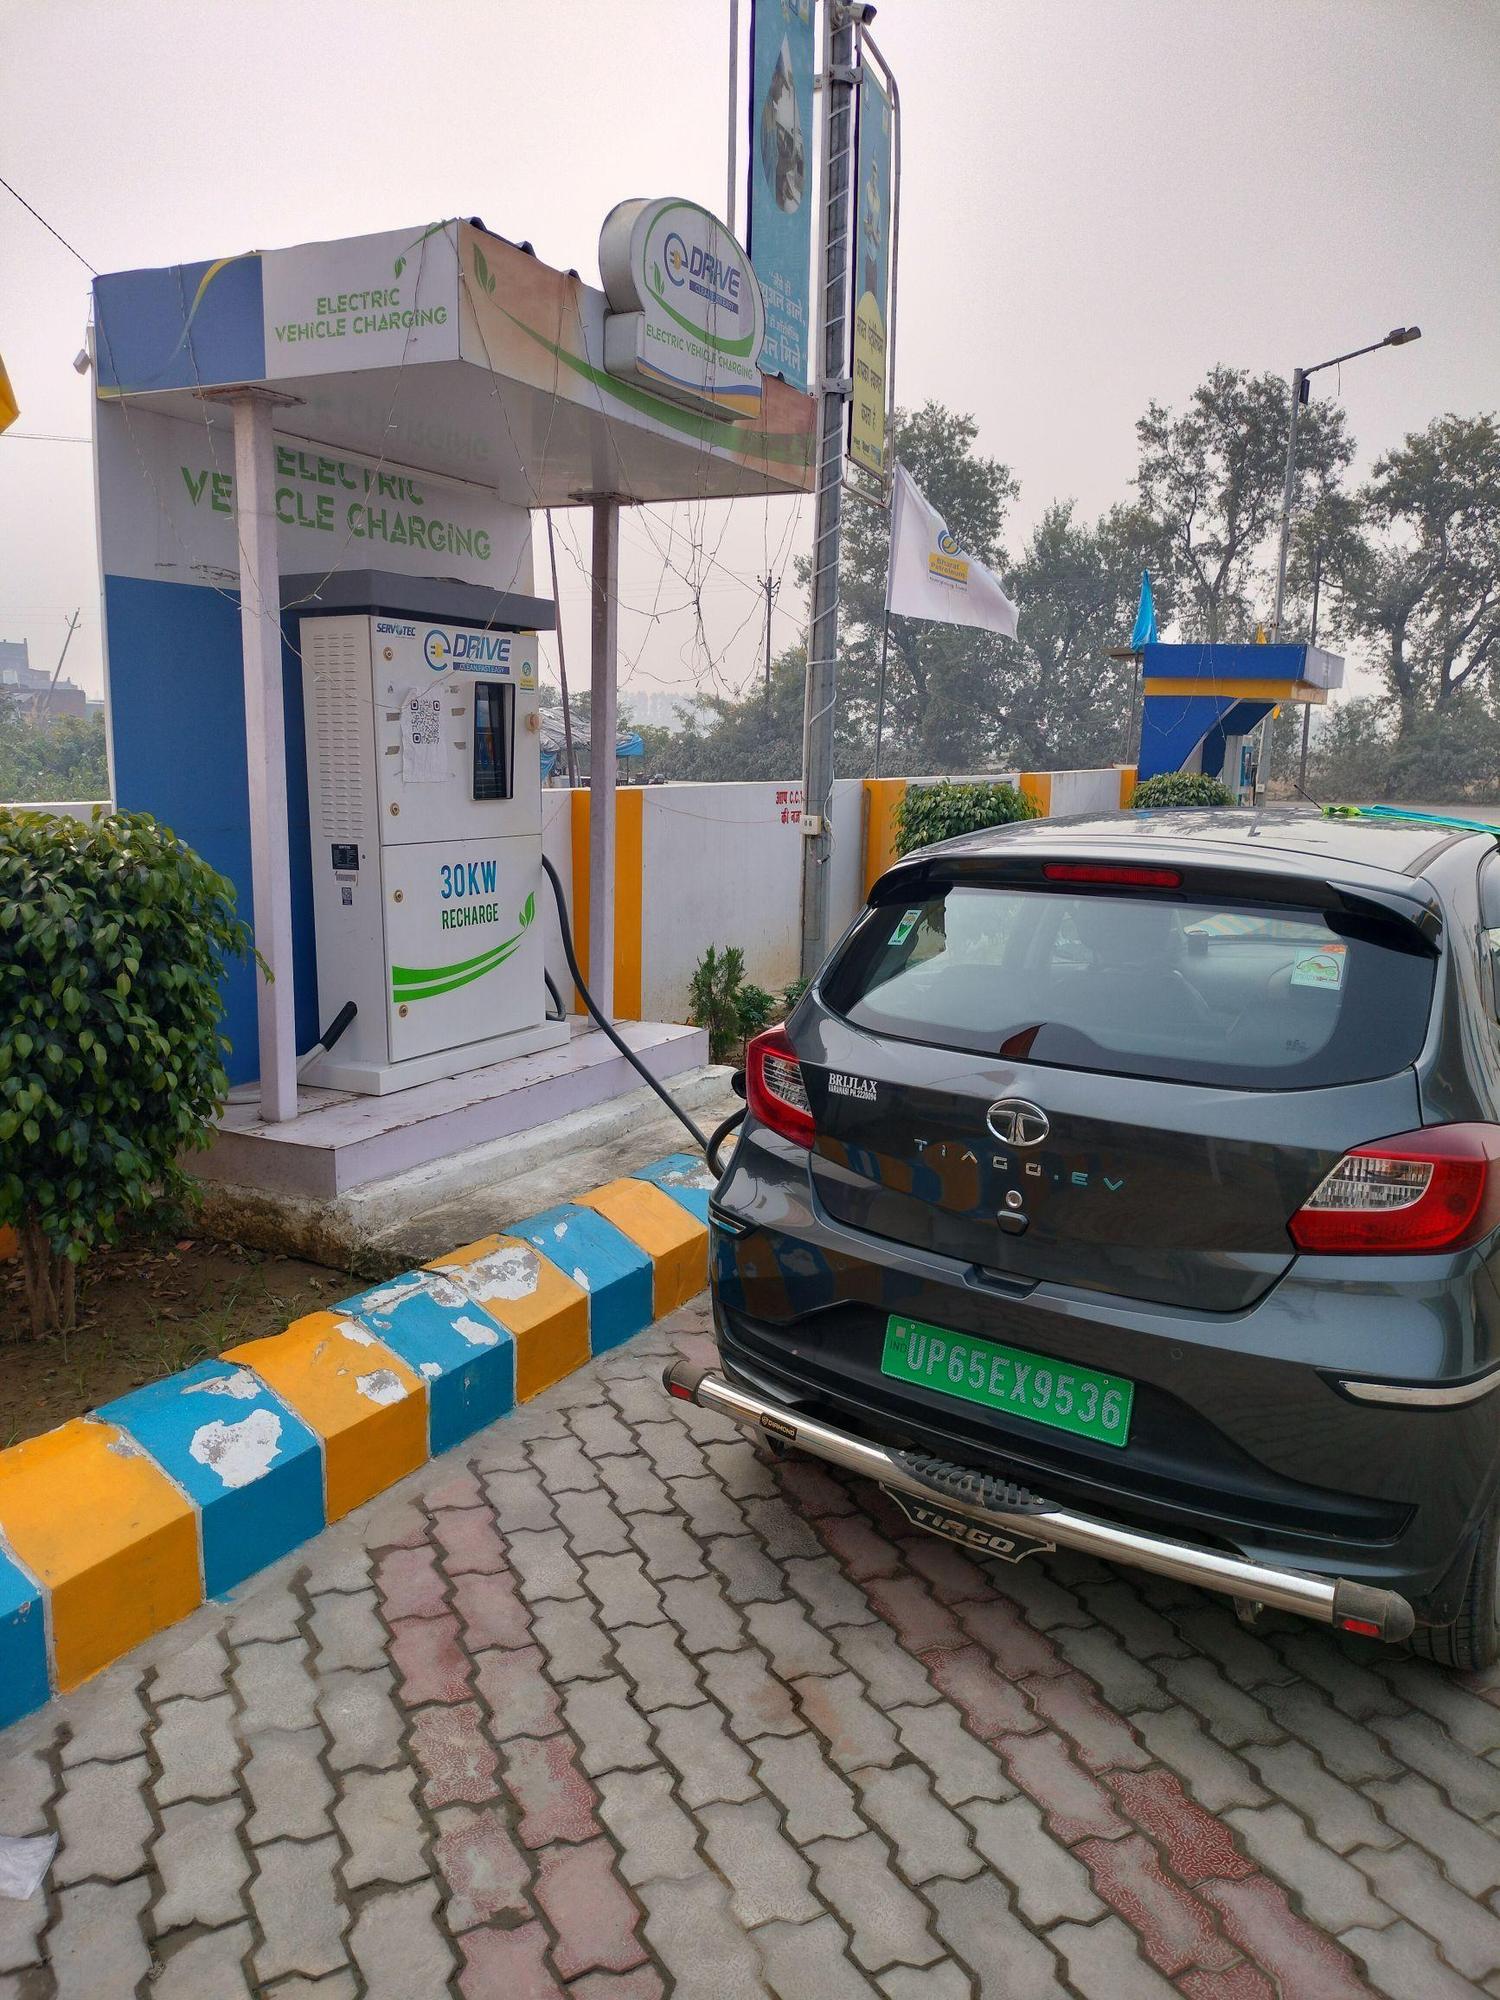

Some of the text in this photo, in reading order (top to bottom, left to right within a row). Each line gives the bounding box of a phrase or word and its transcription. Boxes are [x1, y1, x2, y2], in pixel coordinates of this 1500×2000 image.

[690, 245, 741, 298] DRIVE
[316, 288, 400, 316] ELECTRIC
[275, 306, 448, 343] VEHICLE CHARGING
[646, 323, 753, 380] ELECTRIC VEHICLE CHARGING
[277, 445, 425, 506] ELECTRIC
[180, 465, 492, 561] VECLE CHARGING
[453, 633, 511, 662] DRIVE
[440, 860, 497, 900] 30KW
[441, 902, 499, 930] RECHARGE
[828, 1072, 878, 1094] BRIJLAX
[906, 1332, 1123, 1430] UP65EX9536
